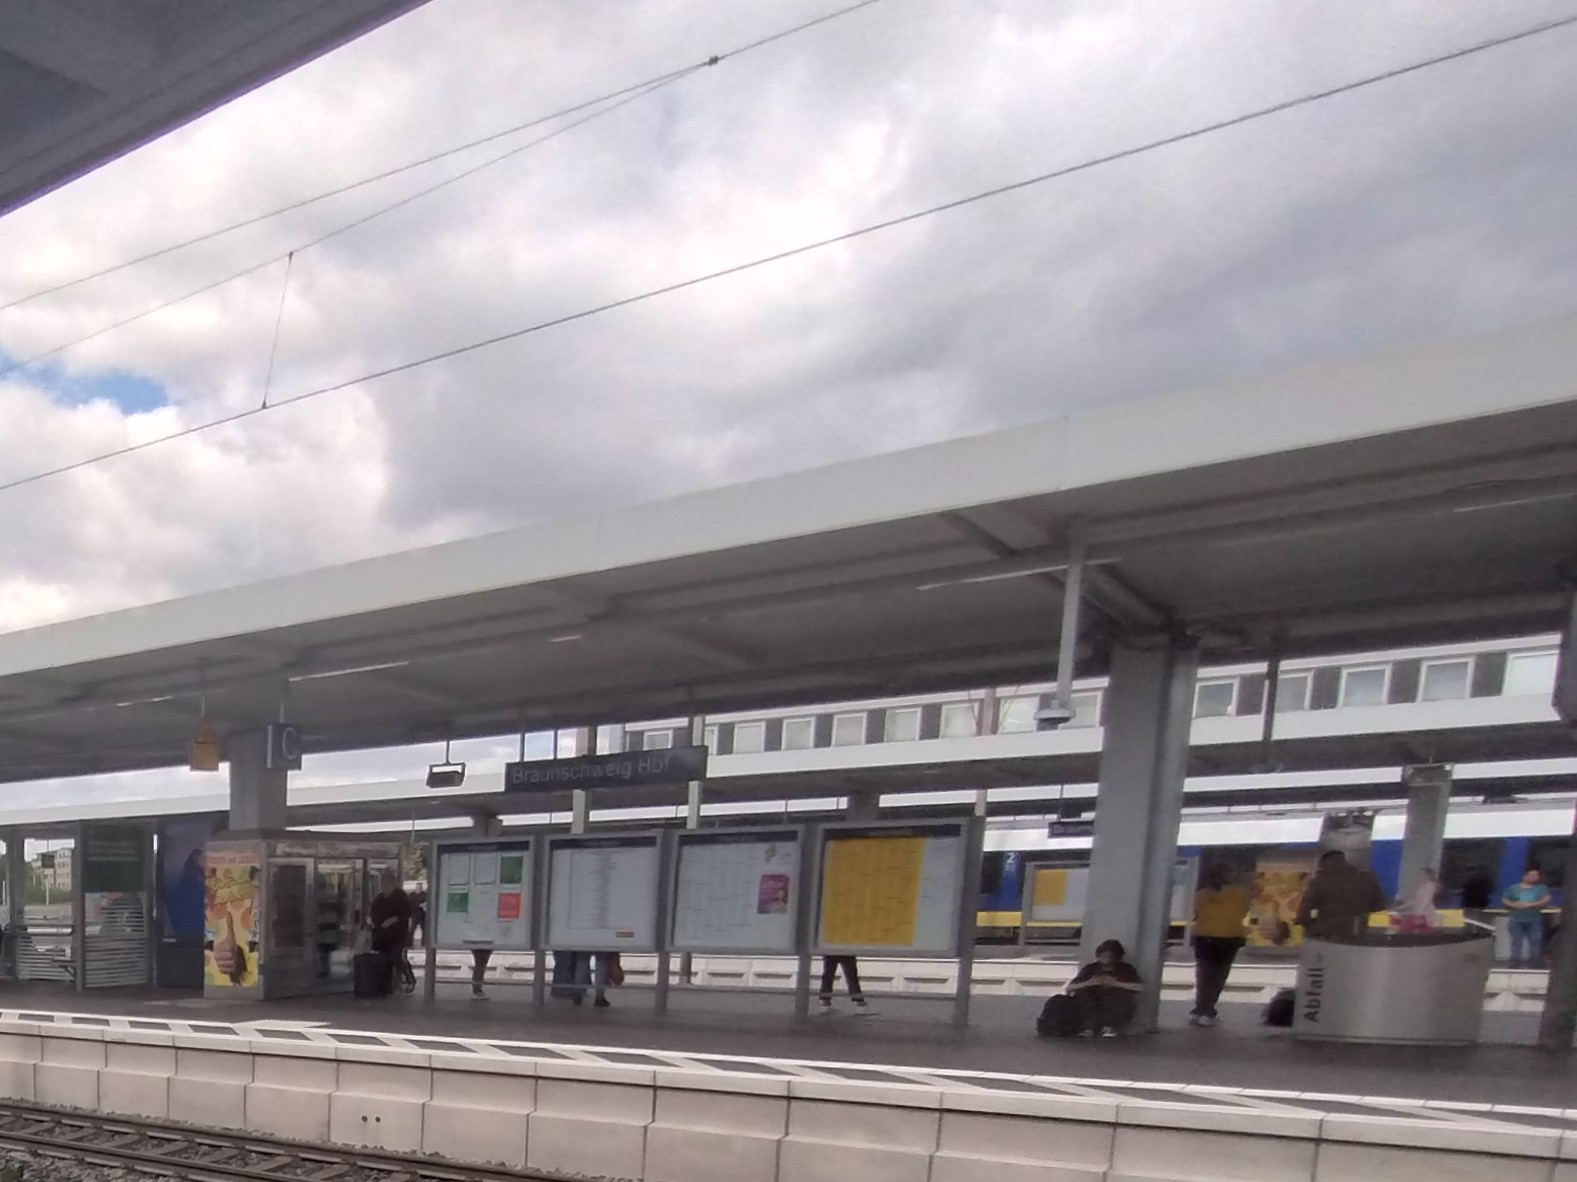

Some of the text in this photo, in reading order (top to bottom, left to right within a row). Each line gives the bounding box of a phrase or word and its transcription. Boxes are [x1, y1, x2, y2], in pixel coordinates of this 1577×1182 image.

[282, 727, 300, 760] C
[512, 753, 671, 784] Braunschweig Hbf
[1007, 852, 1015, 864] 2
[1303, 968, 1323, 1022] Abfall
